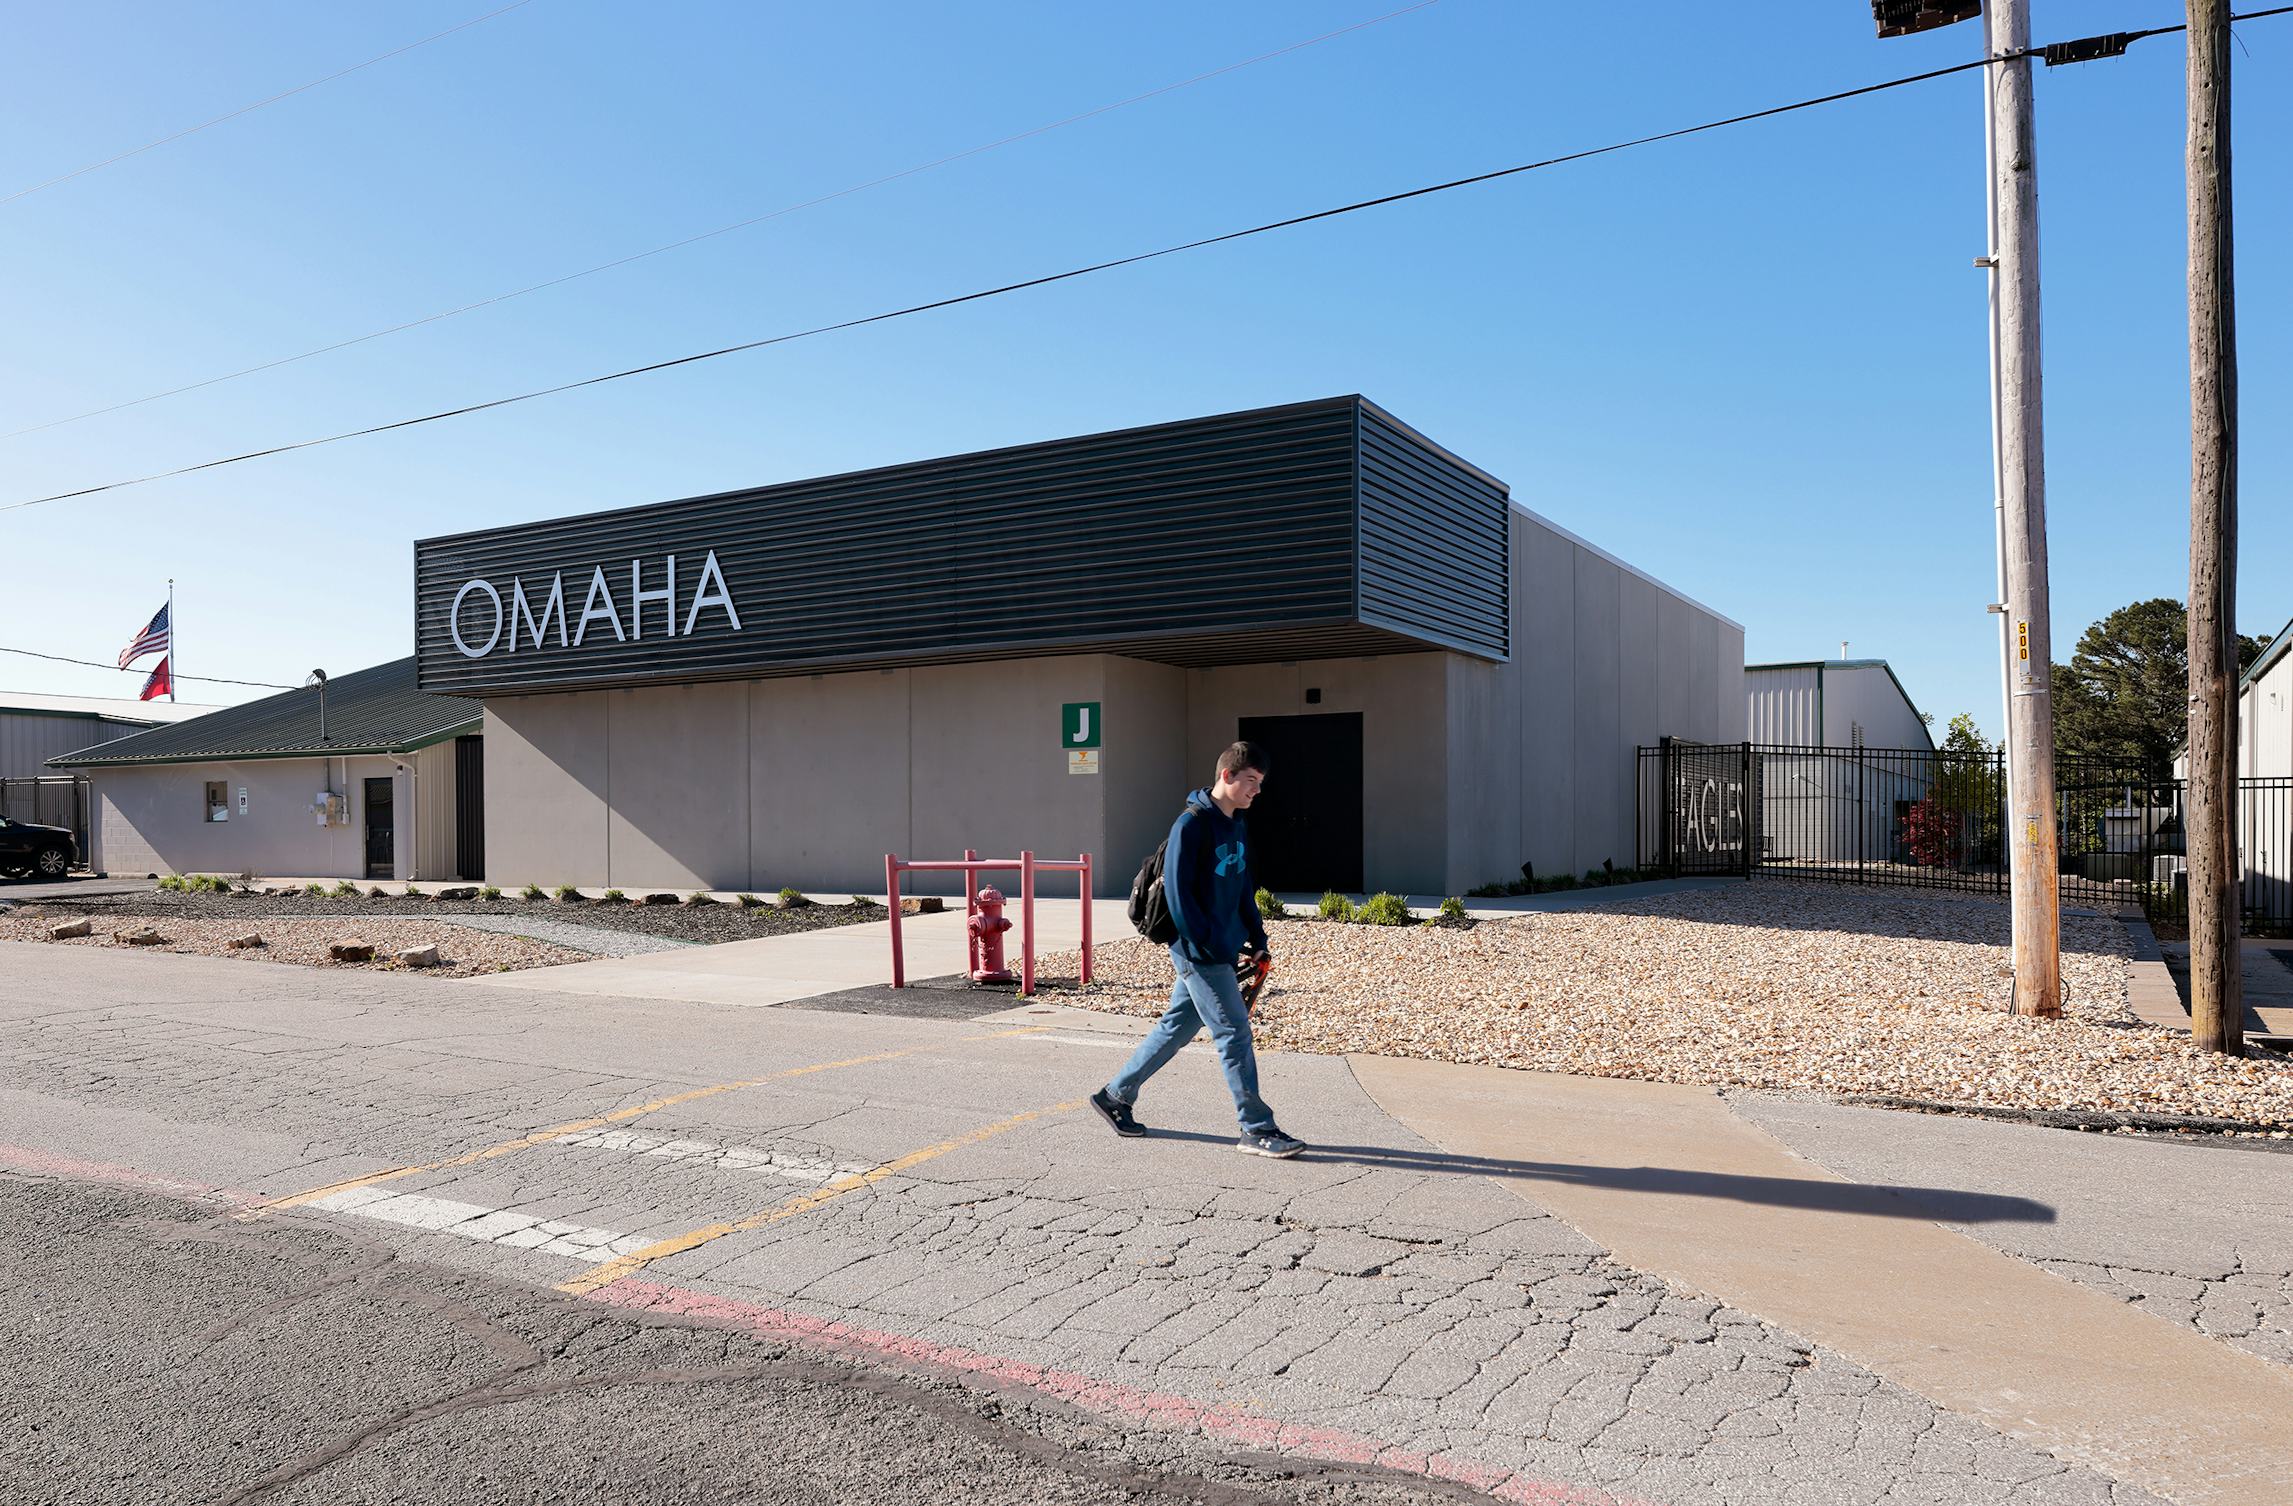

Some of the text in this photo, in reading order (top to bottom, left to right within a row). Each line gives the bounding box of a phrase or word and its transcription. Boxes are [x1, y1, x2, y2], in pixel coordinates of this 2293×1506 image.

[450, 548, 742, 658] OMAHA
[2019, 622, 2027, 660] 500
[1072, 707, 1090, 743] J
